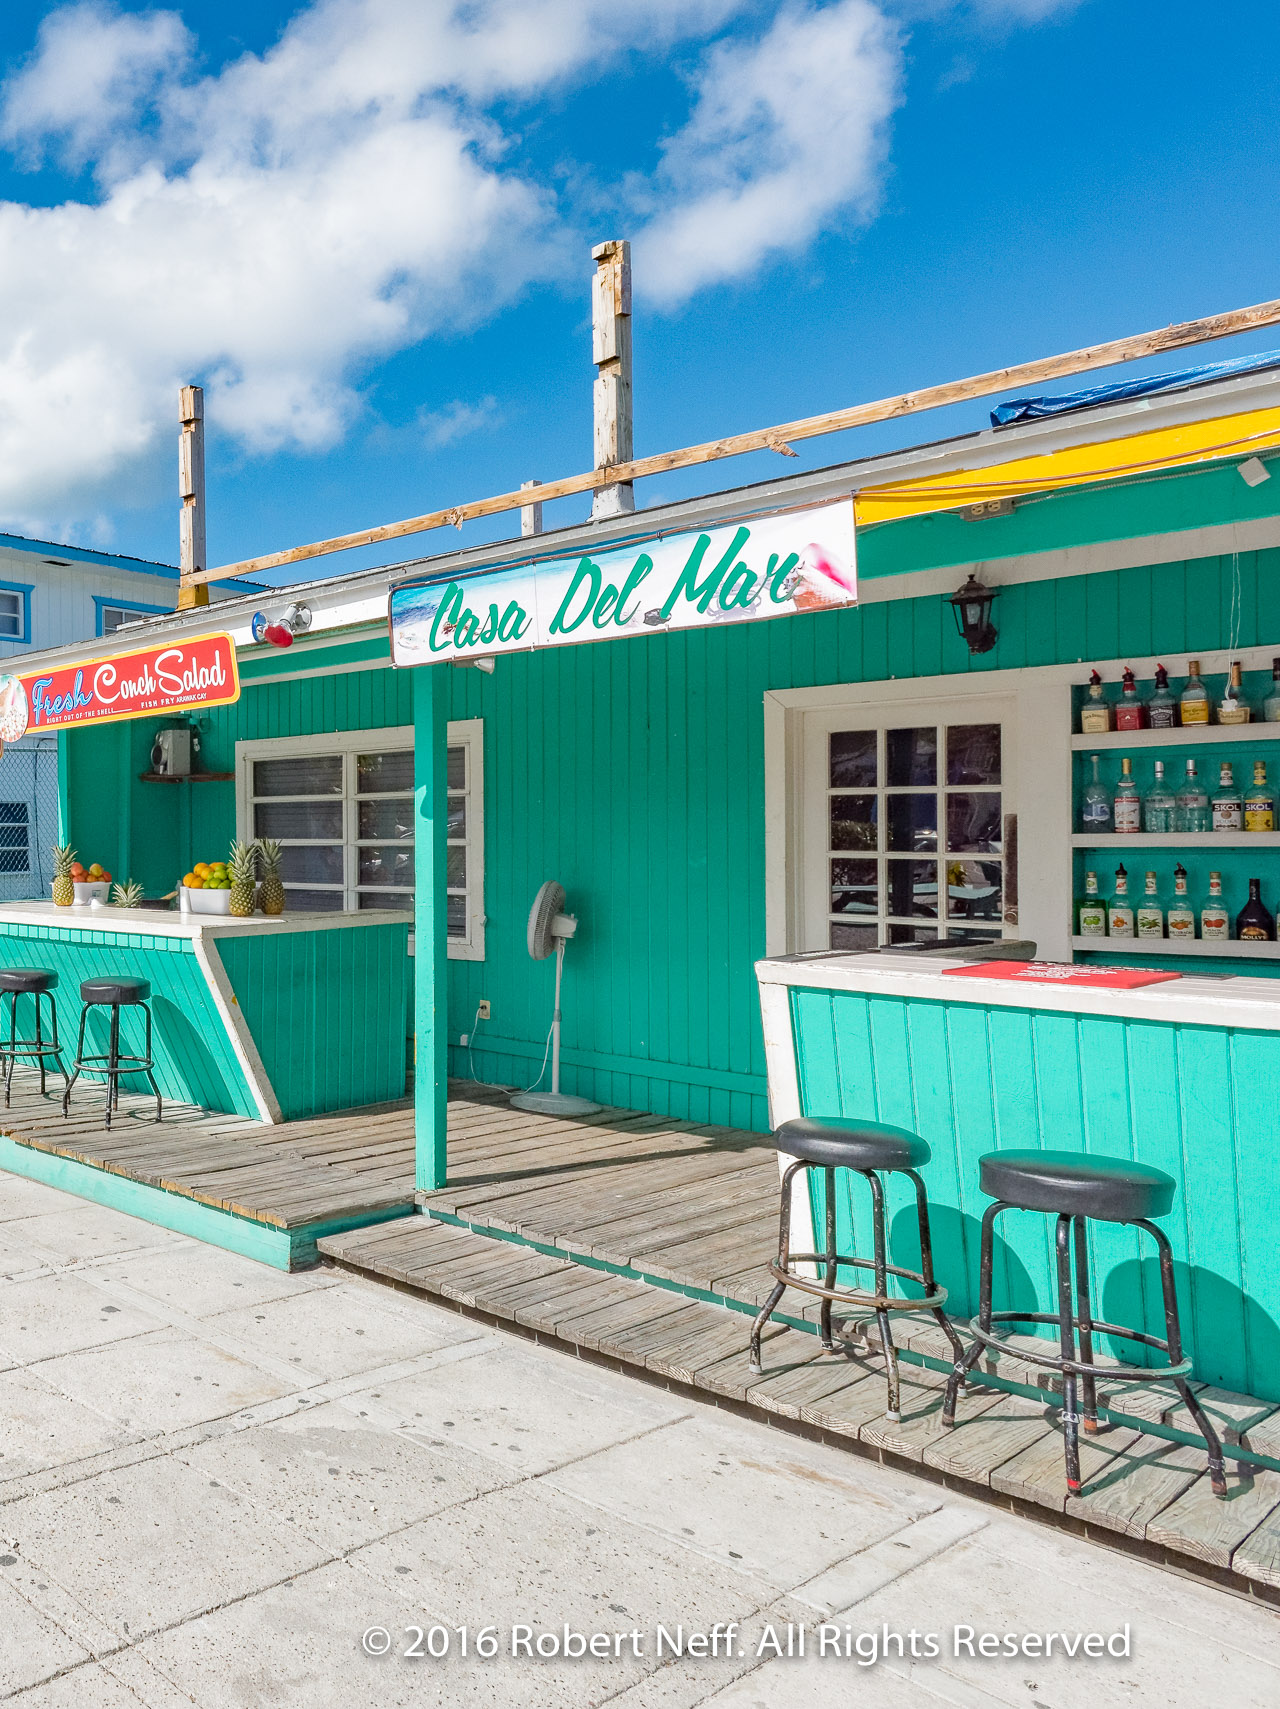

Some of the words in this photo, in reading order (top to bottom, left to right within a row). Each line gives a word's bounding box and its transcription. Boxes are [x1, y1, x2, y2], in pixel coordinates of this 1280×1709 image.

[429, 581, 532, 652] Casa
[549, 553, 653, 635] Del
[660, 526, 801, 620] Mar
[31, 669, 93, 725] Fresh
[94, 663, 157, 704] Conch
[154, 649, 226, 695] Salad
[140, 700, 158, 709] FISH
[160, 697, 175, 705] FRY
[175, 694, 197, 704] ARAWAK
[196, 692, 207, 700] CAY
[46, 716, 63, 726] RIGHT
[63, 714, 74, 723] OUT
[84, 710, 95, 718] THE
[97, 707, 115, 716] SHELL
